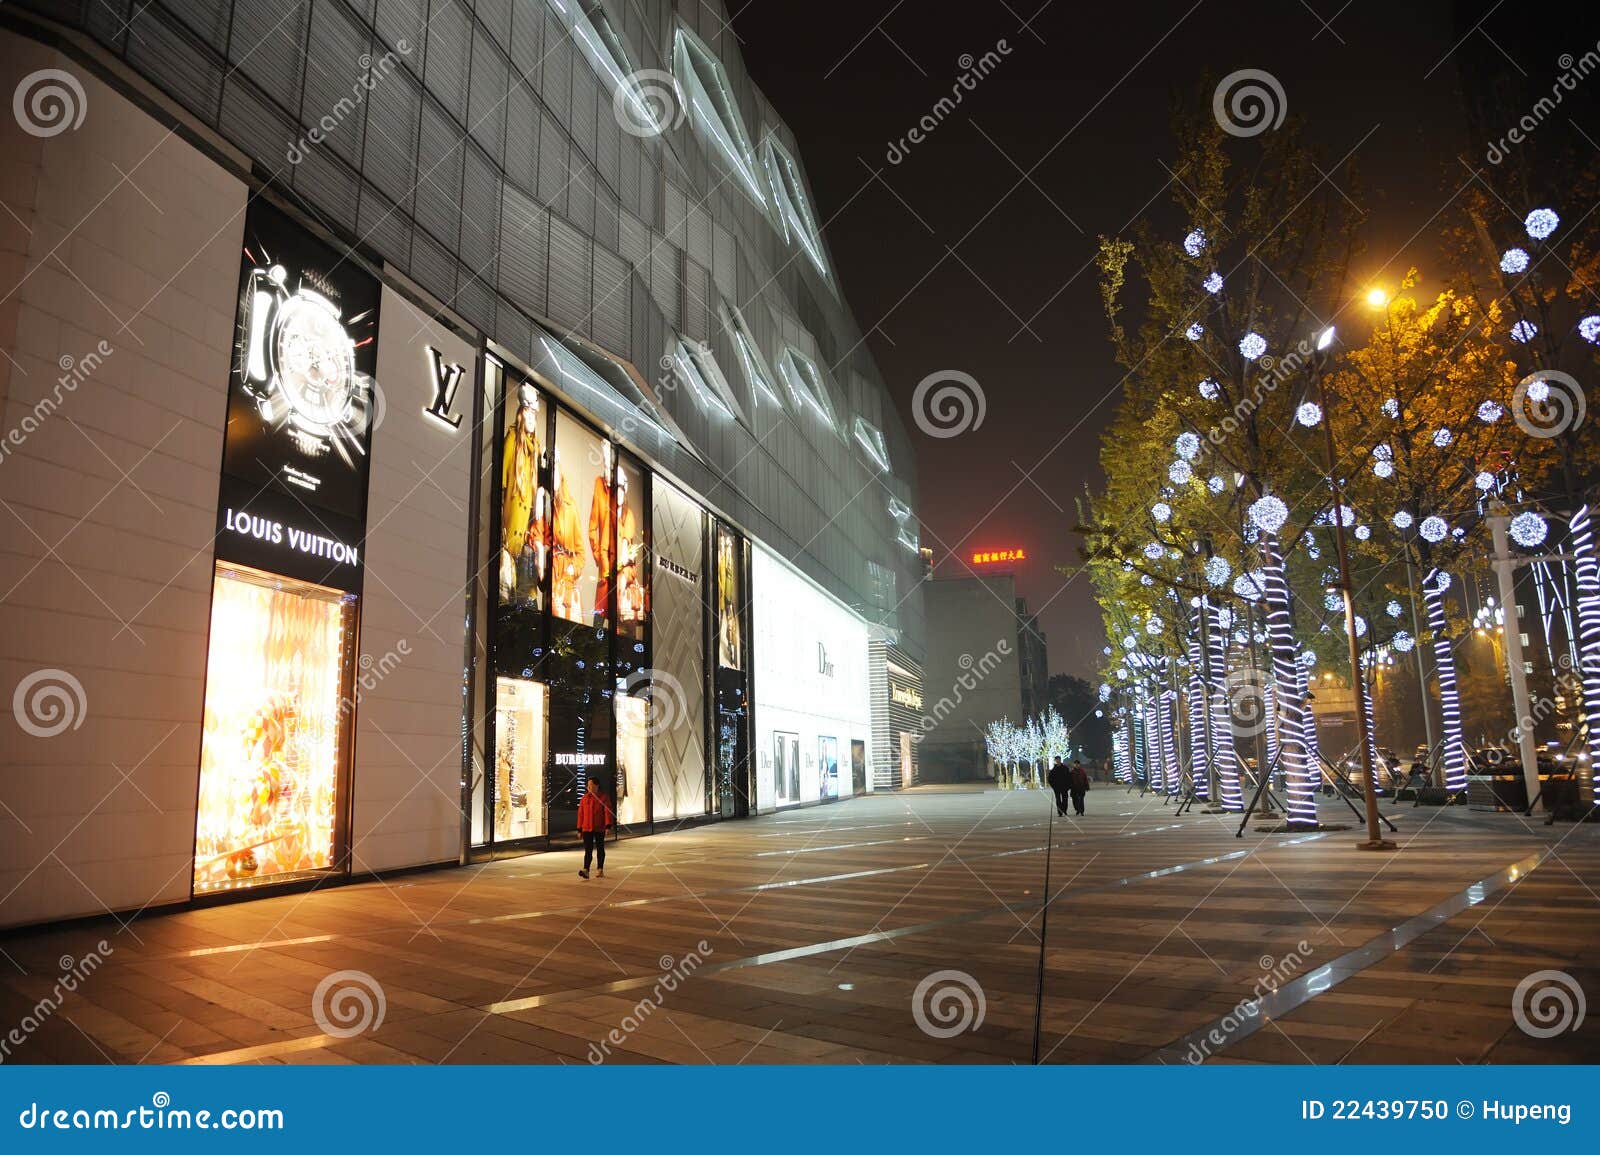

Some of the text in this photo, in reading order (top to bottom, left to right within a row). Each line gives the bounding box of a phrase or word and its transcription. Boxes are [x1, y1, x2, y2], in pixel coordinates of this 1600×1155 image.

[226, 508, 358, 567] LOUIS VUITTON
[818, 641, 834, 678] Dior
[555, 753, 606, 765] BURBERRY
